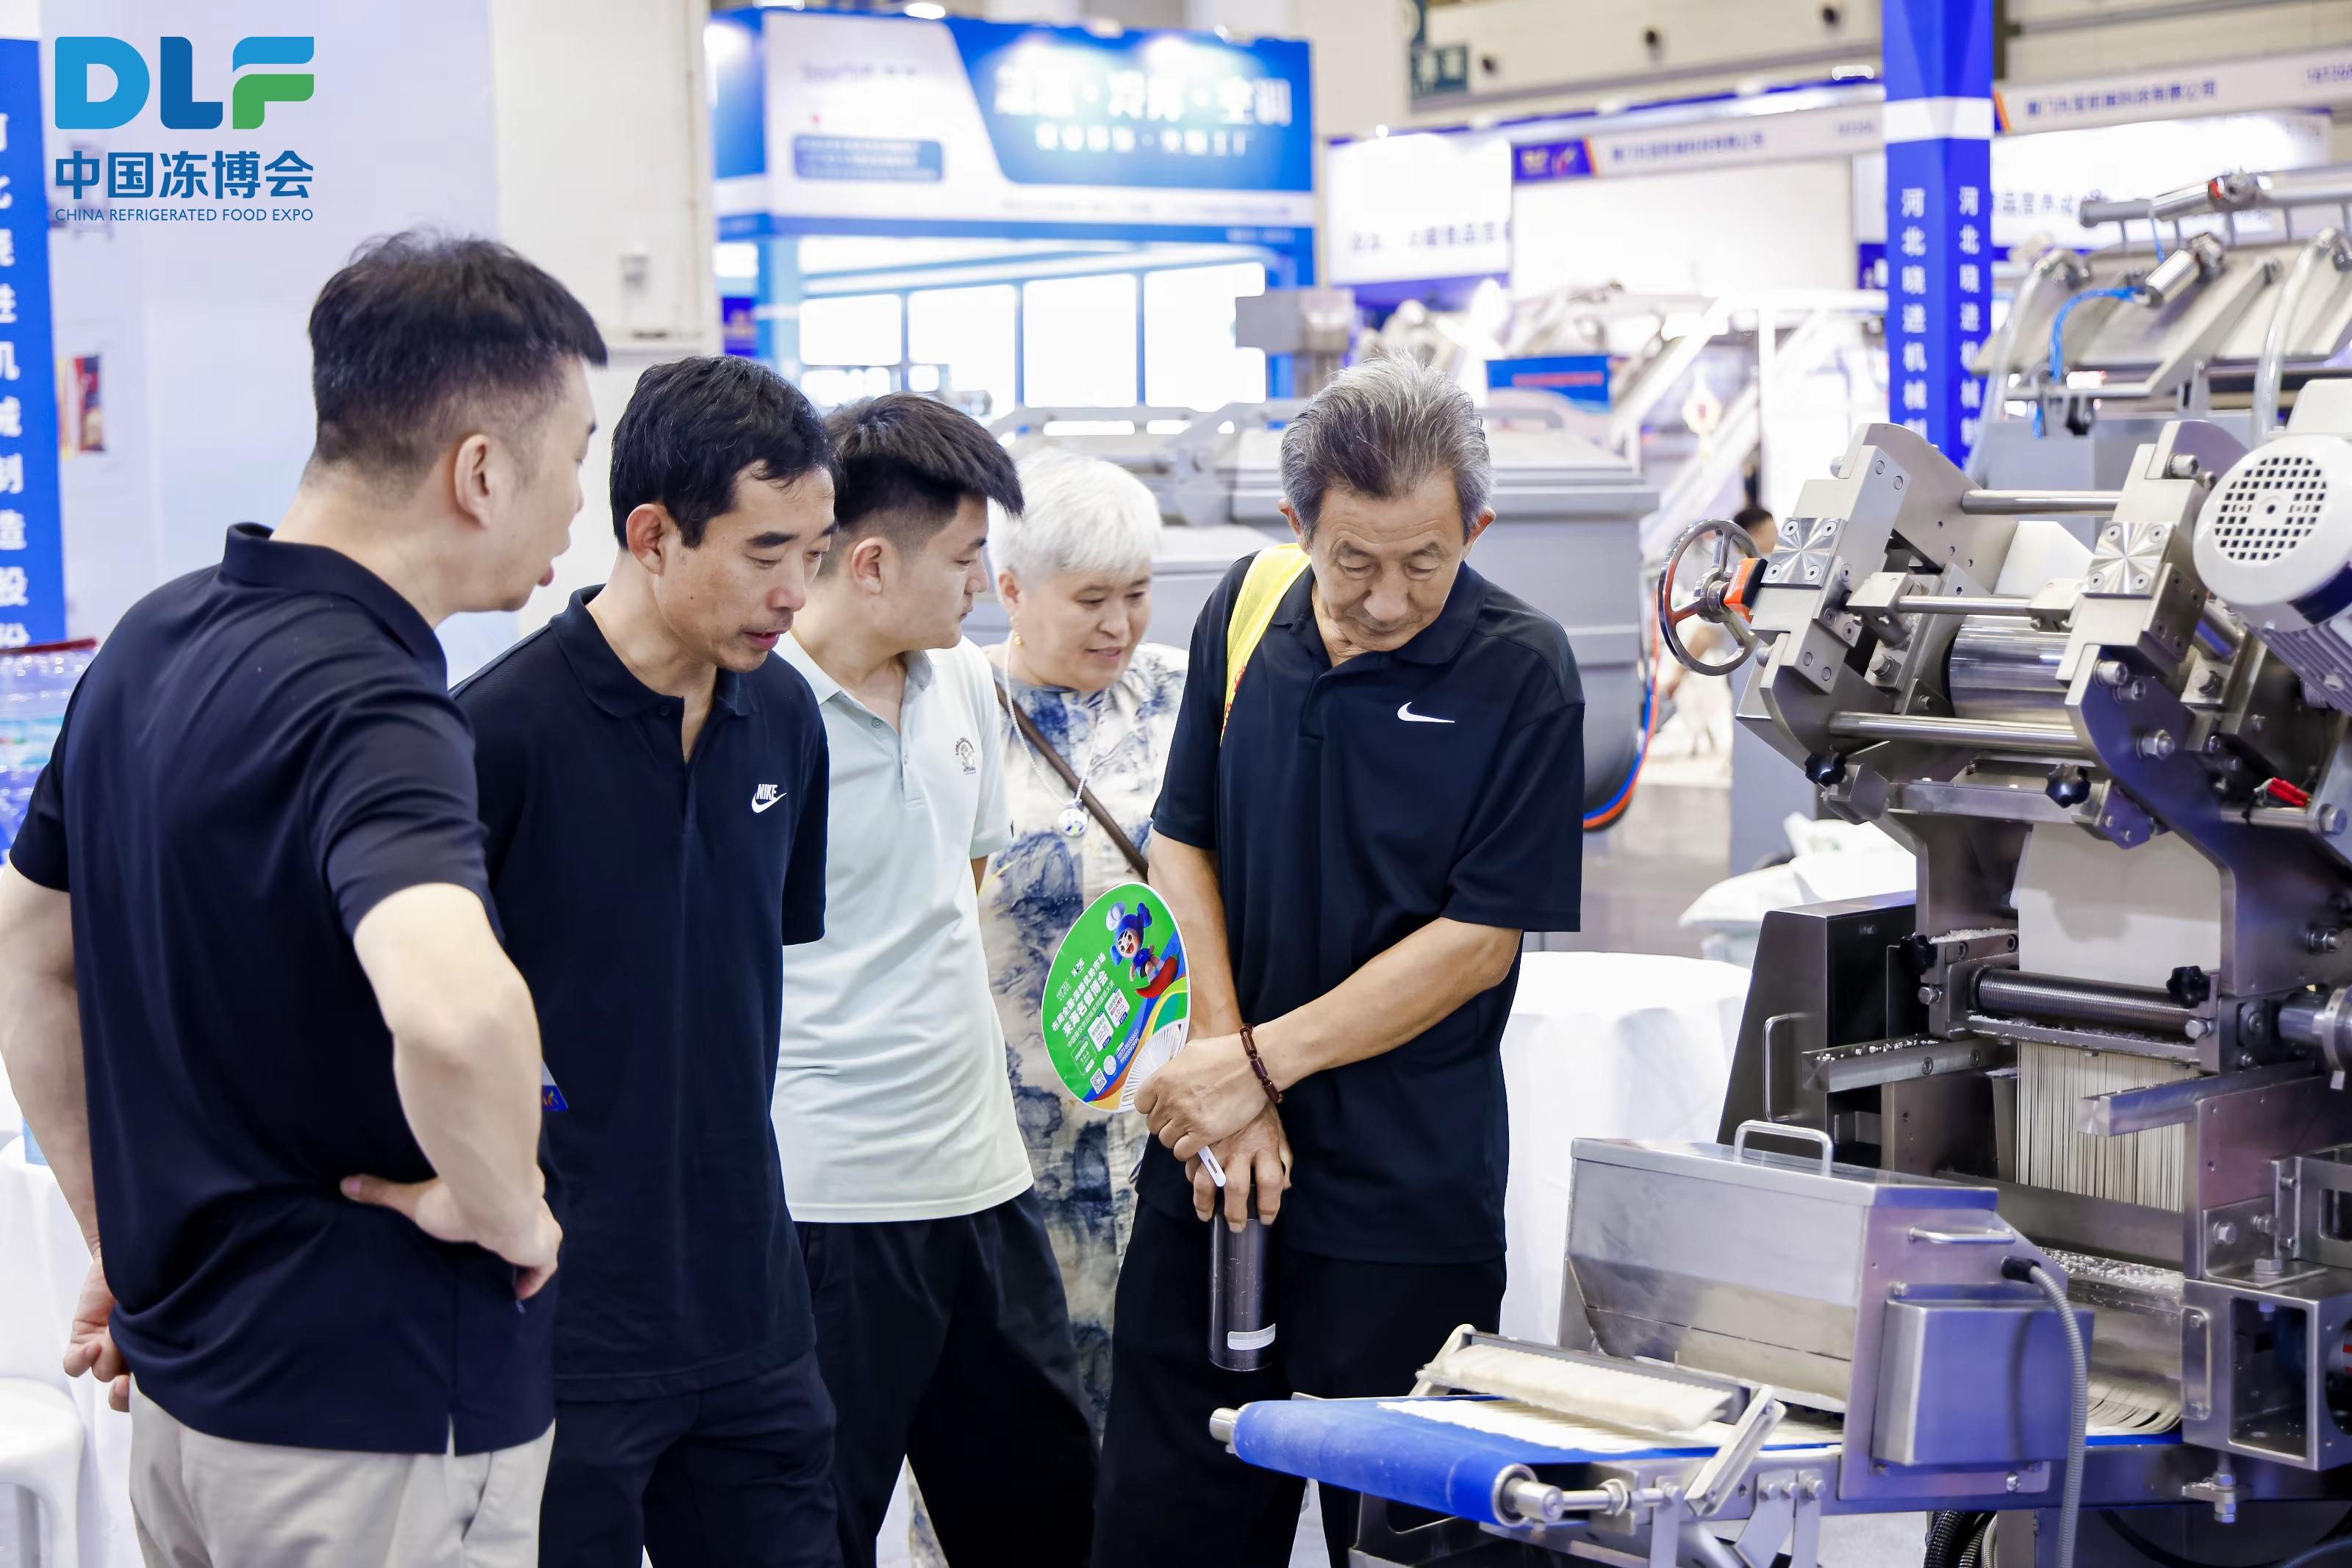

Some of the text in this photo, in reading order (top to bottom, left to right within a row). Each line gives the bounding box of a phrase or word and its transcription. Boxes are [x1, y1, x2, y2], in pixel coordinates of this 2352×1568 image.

[1959, 186, 1981, 464] 河北晓进机械制
[756, 783, 778, 800] NIKE
